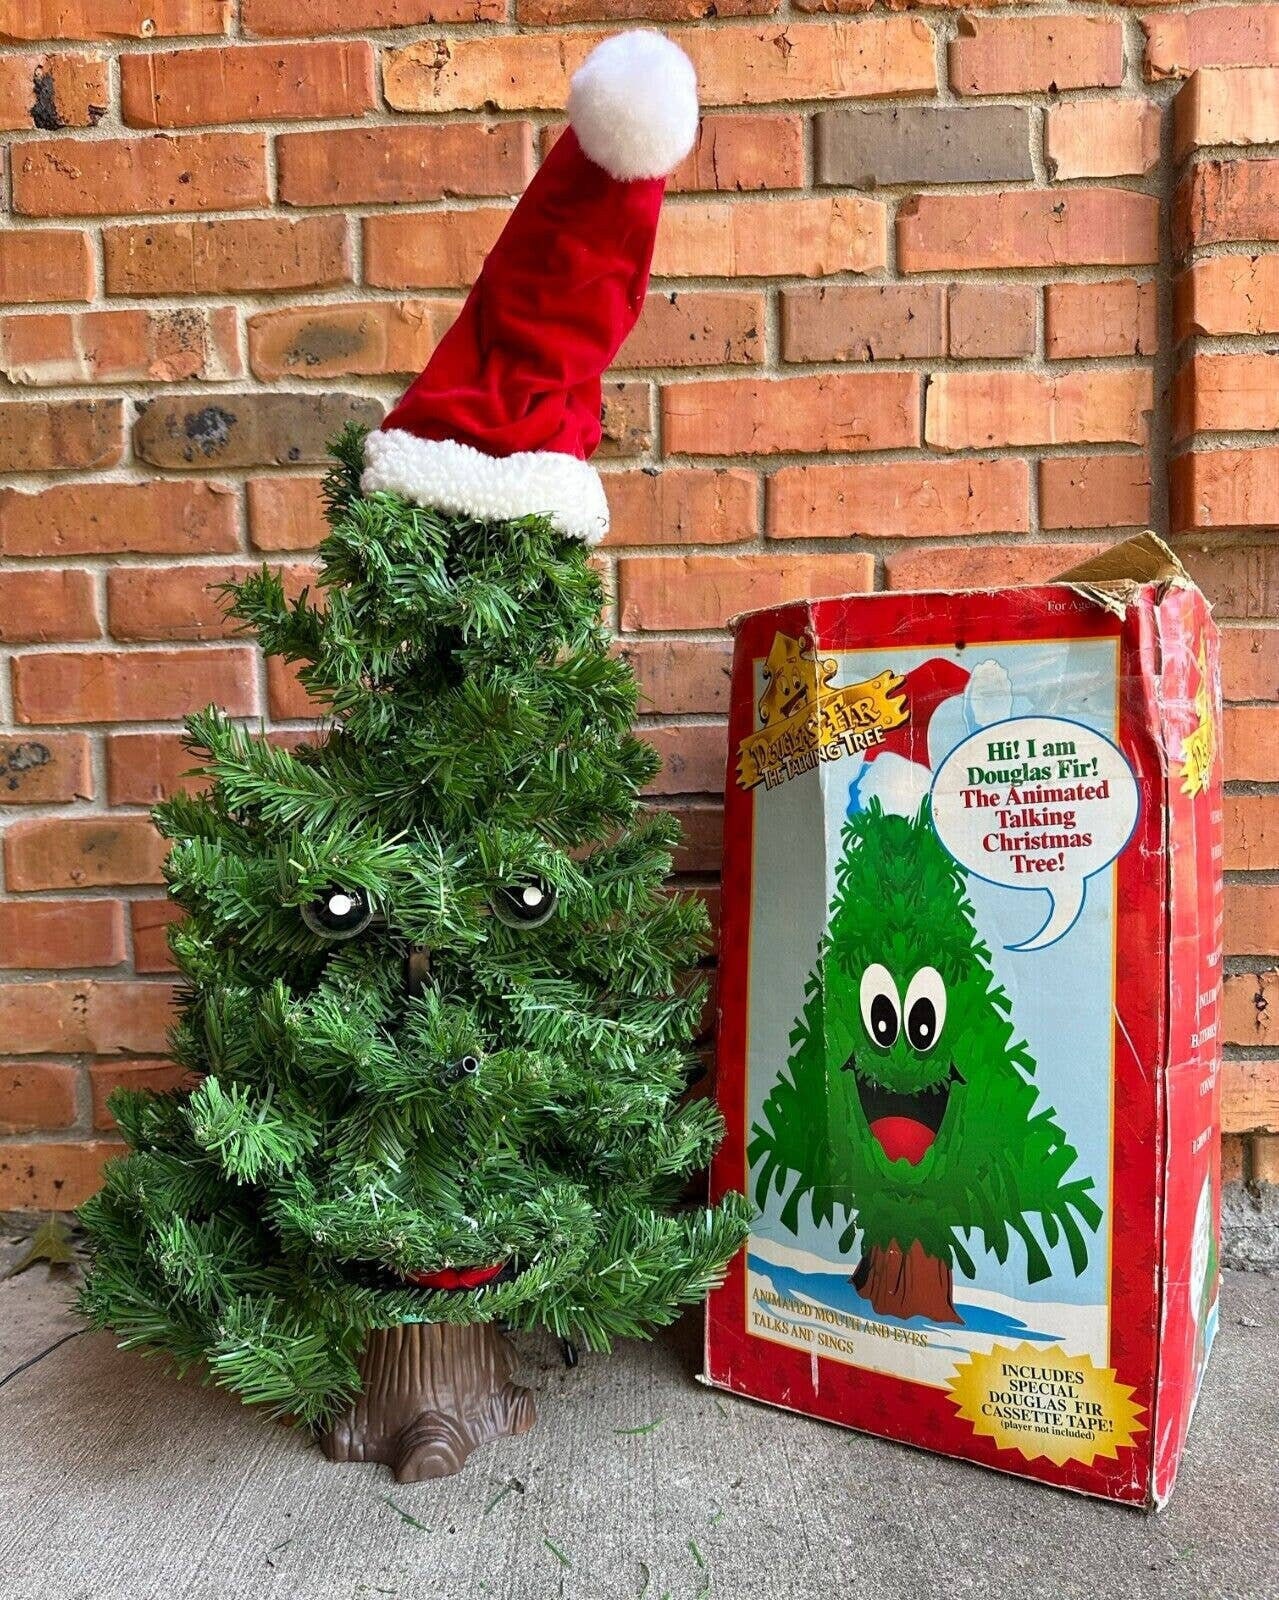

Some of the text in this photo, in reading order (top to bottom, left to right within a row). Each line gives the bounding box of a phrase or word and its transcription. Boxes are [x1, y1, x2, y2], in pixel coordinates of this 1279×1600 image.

[824, 694, 881, 735] FIR
[760, 726, 886, 791] THE TALKING TREE
[987, 739, 1076, 761] Hi! I am
[967, 757, 1098, 787] Douglas Fir!
[960, 780, 1110, 808] The Animated
[995, 807, 1076, 829] Talking
[982, 831, 1092, 852] Christmas
[1010, 852, 1065, 873] Tree!
[752, 1287, 928, 1348] ANIMATED MOUTH AND EYES
[752, 1311, 789, 1334] TALKS
[817, 1333, 854, 1354] SINGS
[1001, 1363, 1085, 1384] INCLUDES
[1009, 1379, 1079, 1399] SPECIAL
[989, 1391, 1103, 1416] DOUGLAS FIR
[981, 1403, 1114, 1432] CASSETTE TAPE!
[1000, 1420, 1095, 1441] (player not included)
